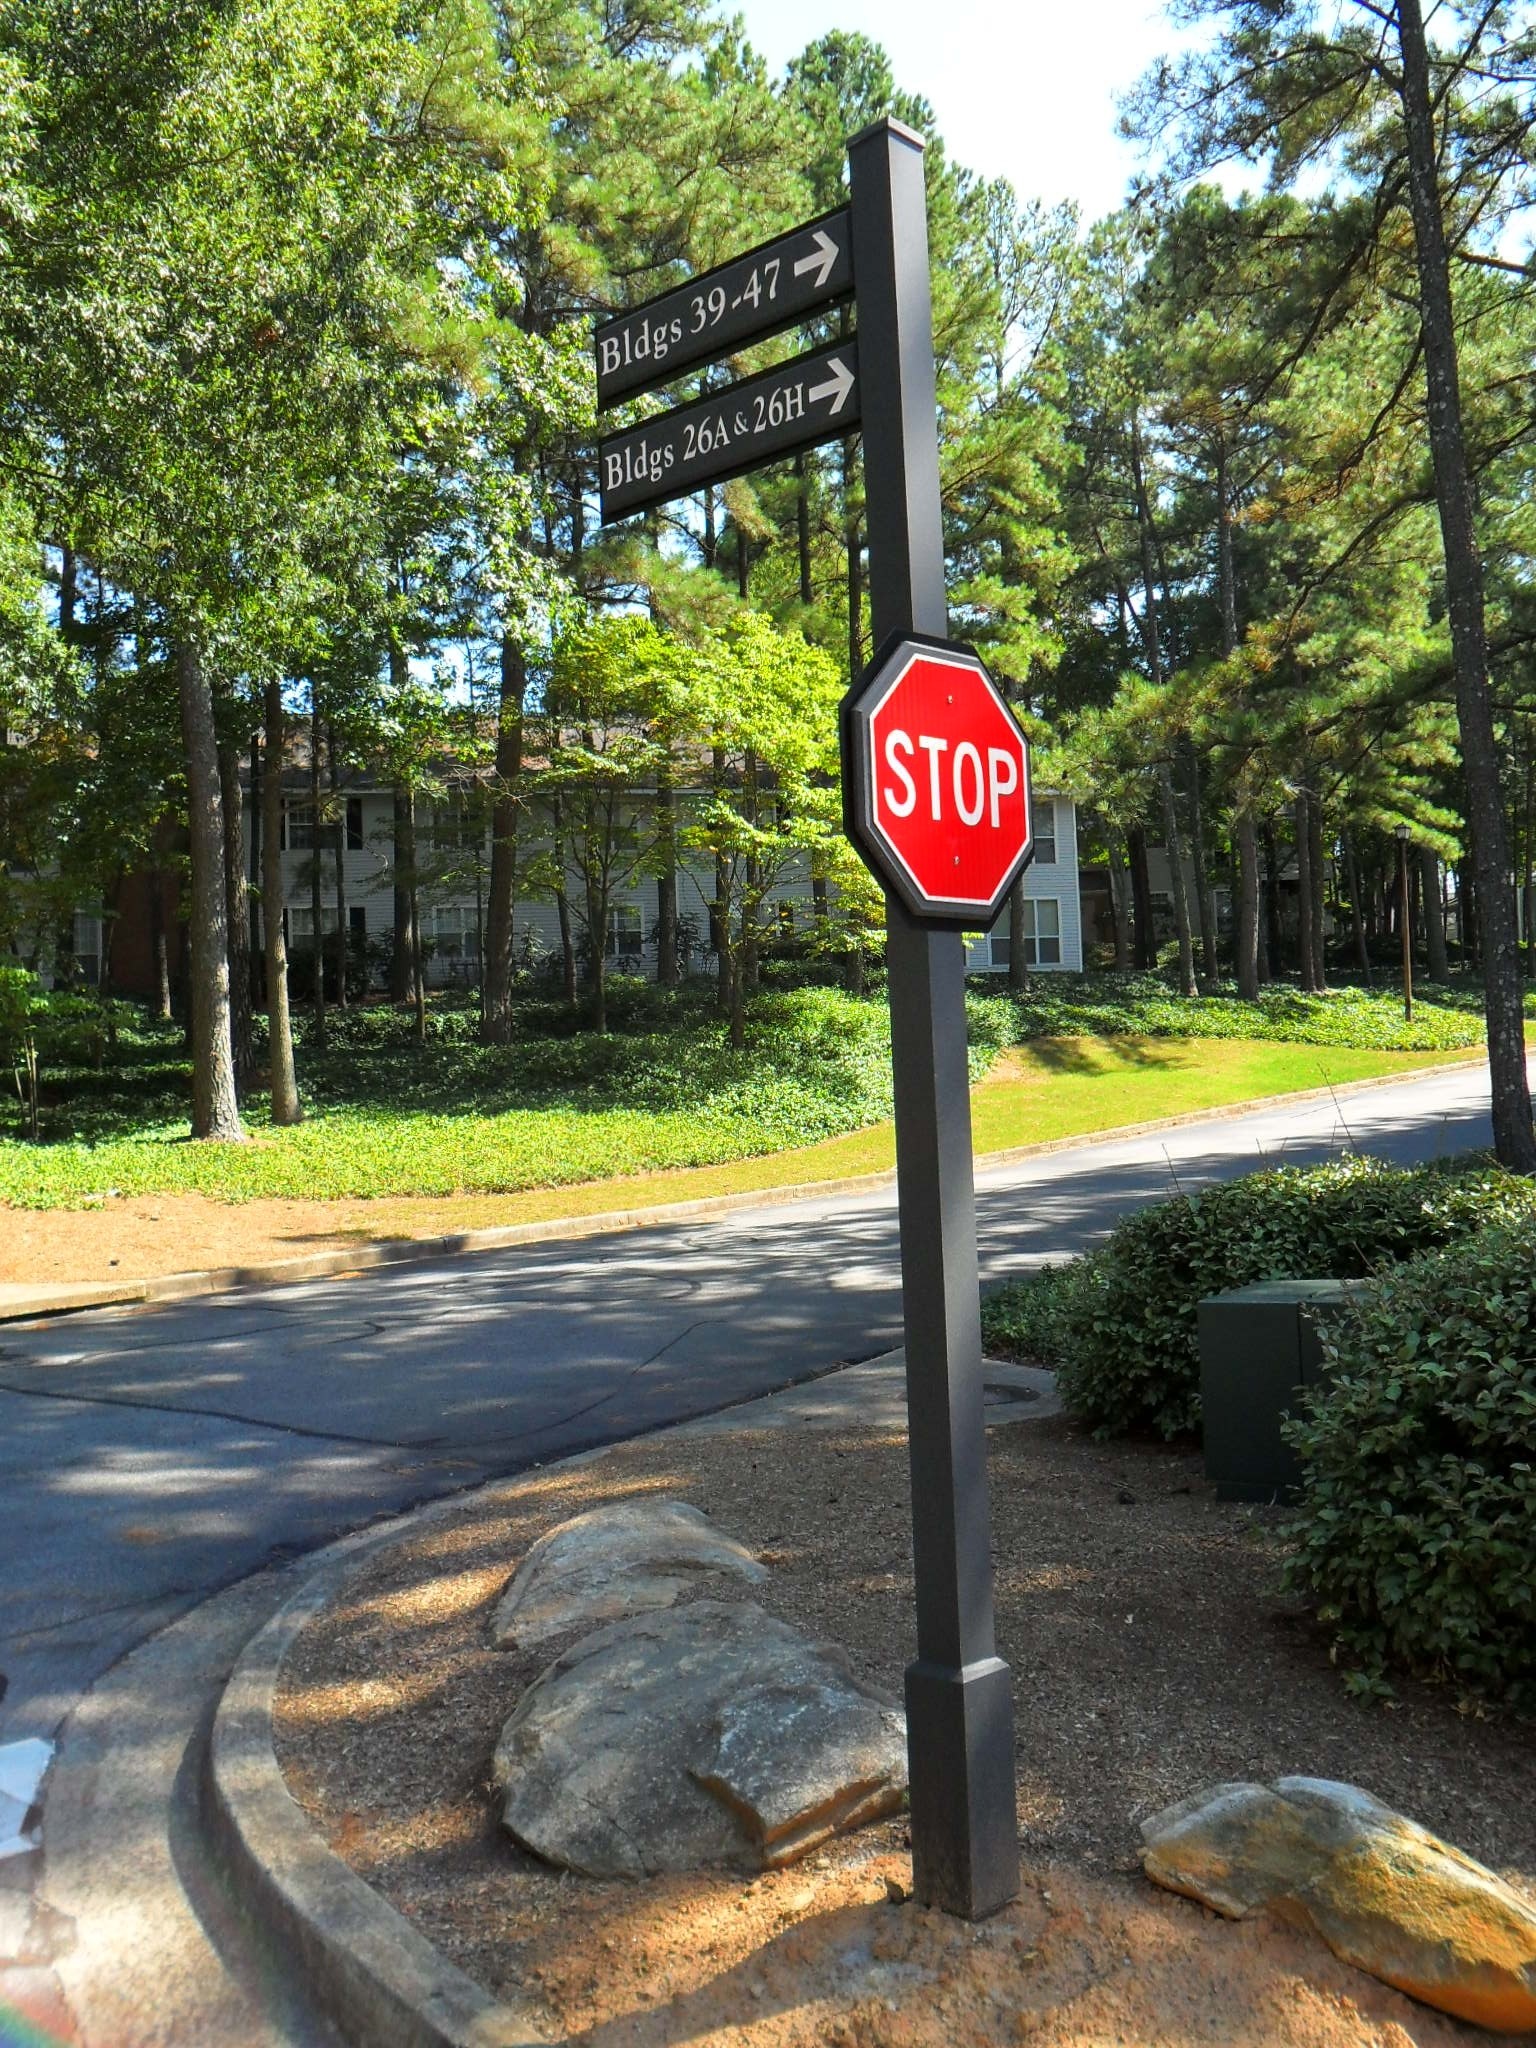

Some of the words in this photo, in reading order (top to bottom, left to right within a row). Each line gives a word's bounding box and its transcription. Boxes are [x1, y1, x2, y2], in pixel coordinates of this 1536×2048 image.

[600, 318, 682, 376] Bldgs
[690, 258, 781, 334] 39-47
[605, 440, 674, 491] Bldgs
[683, 415, 731, 461] 26A
[734, 411, 749, 436] &
[753, 382, 805, 434] 26H
[883, 729, 1018, 828] STOP
